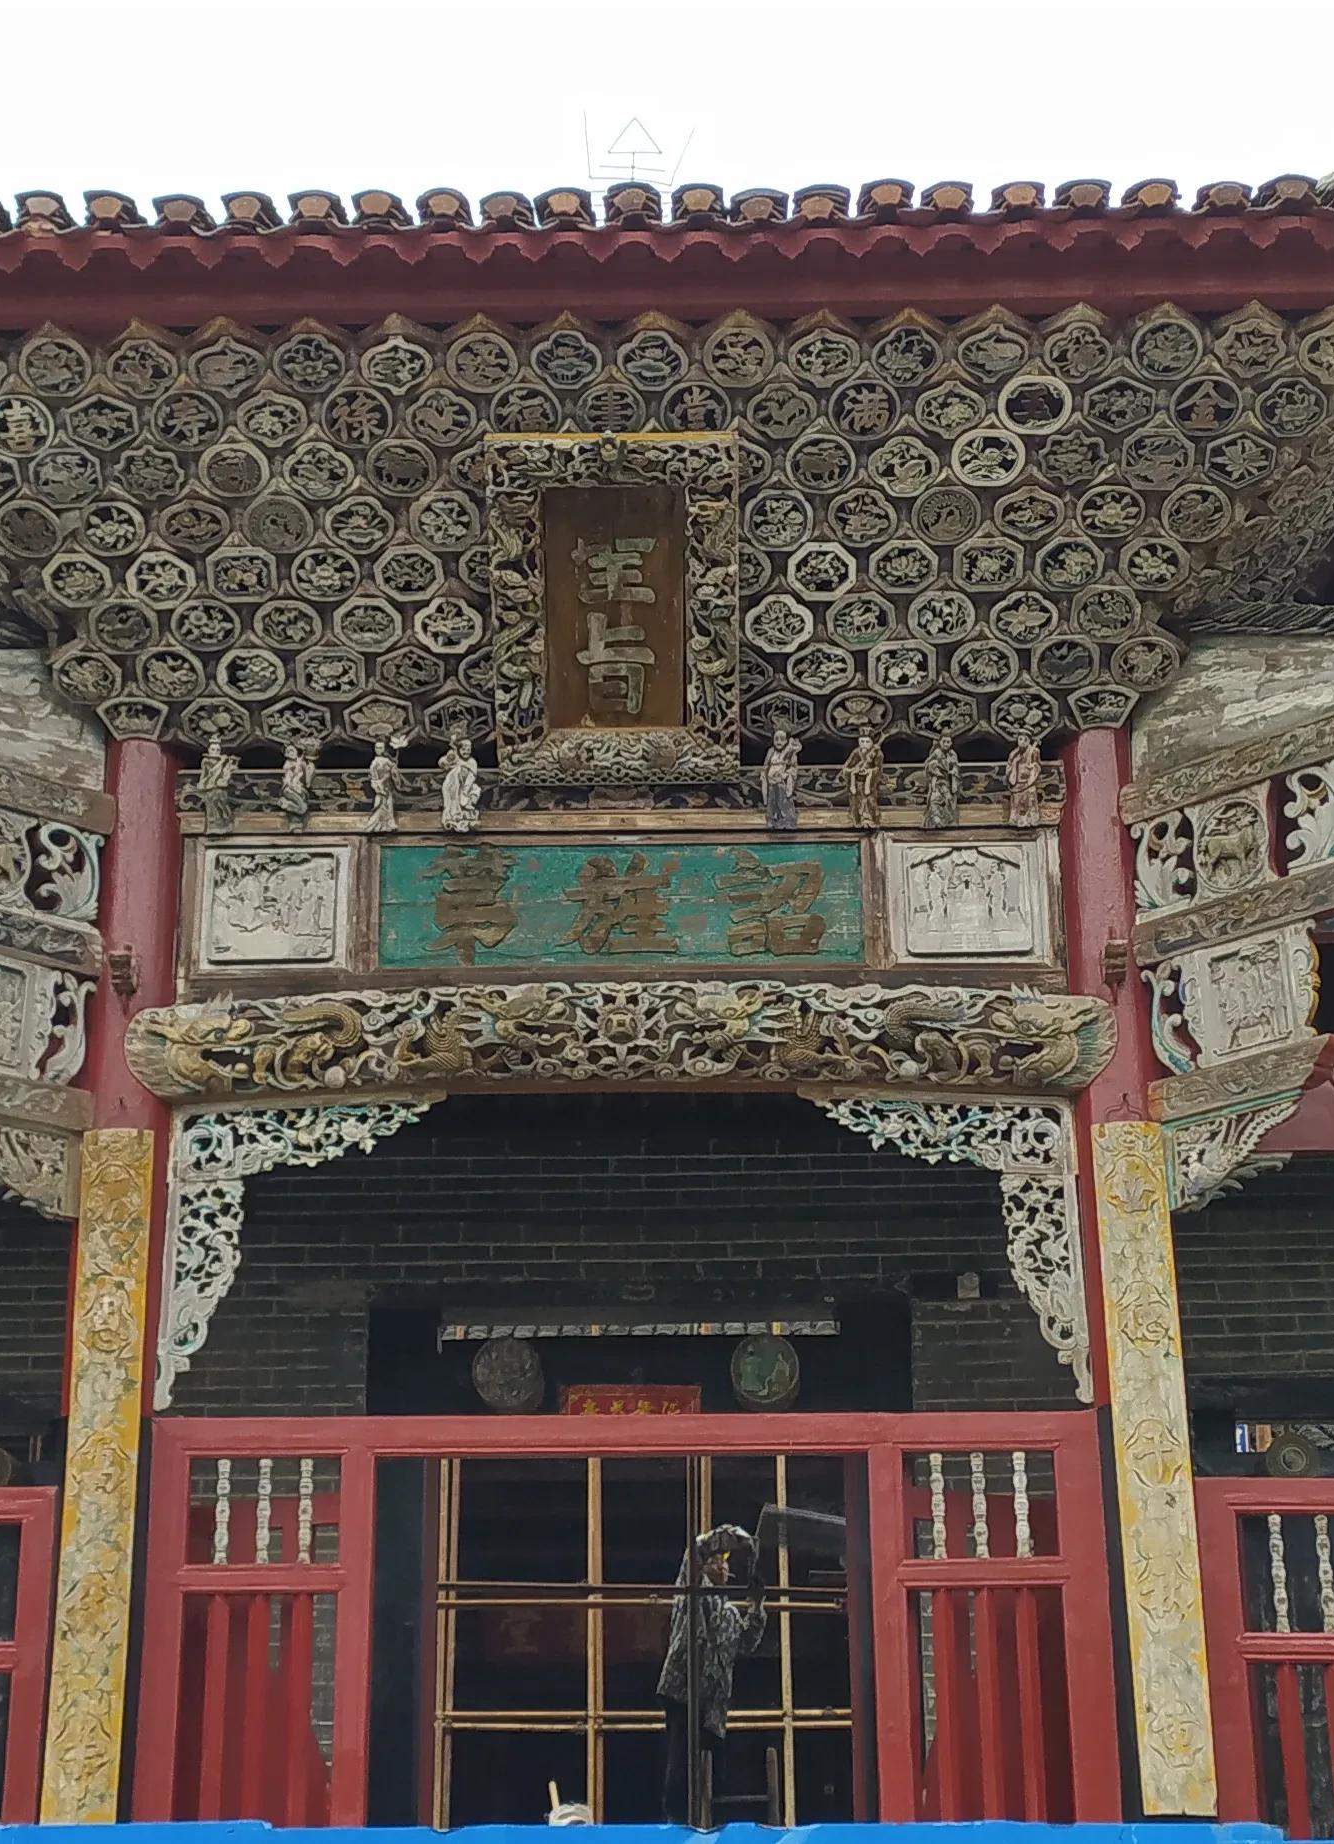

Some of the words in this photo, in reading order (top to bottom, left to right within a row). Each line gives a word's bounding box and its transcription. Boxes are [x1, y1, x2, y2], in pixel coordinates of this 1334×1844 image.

[167, 398, 211, 446] 寿
[331, 391, 384, 443] 禄
[674, 385, 724, 430] 堂
[840, 386, 890, 433] 满
[1176, 381, 1237, 431] 金
